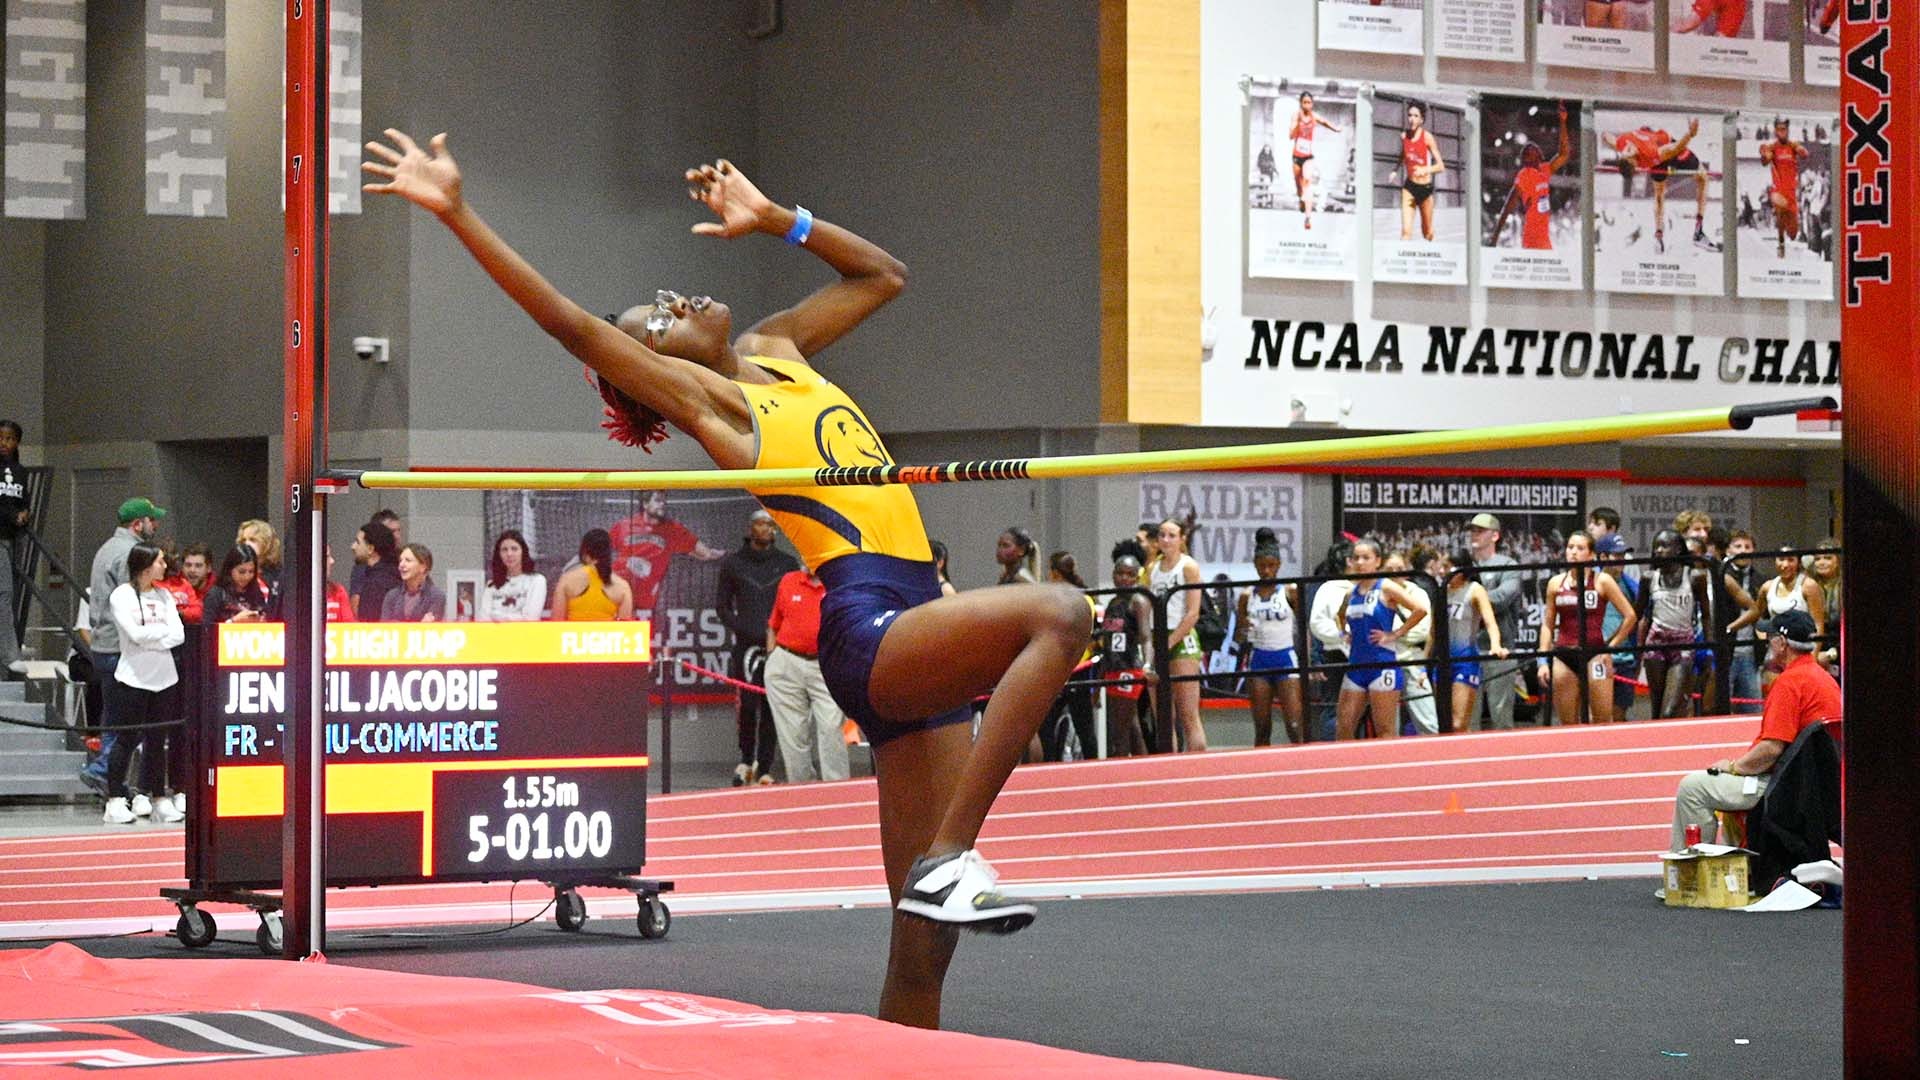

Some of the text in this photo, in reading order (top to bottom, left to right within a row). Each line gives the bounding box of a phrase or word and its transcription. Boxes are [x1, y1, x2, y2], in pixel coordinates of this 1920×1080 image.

[292, 155, 302, 184] 7
[292, 321, 301, 348] 6
[1245, 320, 1403, 373] NCAA
[1422, 326, 1700, 380] NATIONAL
[292, 484, 300, 513] 5
[1141, 483, 1297, 521] RAIDER
[1343, 482, 1578, 507] BIG 12 TEAM CHAMPIONSHIPS
[1630, 495, 1696, 513] WRECK
[224, 630, 467, 660] WOMS HIGH JUMP
[561, 631, 645, 656] FLIGHT: 1
[225, 669, 498, 714] JENIL JACOBIE
[225, 724, 258, 756] FR
[276, 721, 499, 755] U-COMMERCE
[503, 776, 579, 808] 1.55m
[467, 811, 612, 863] 5-01.00
